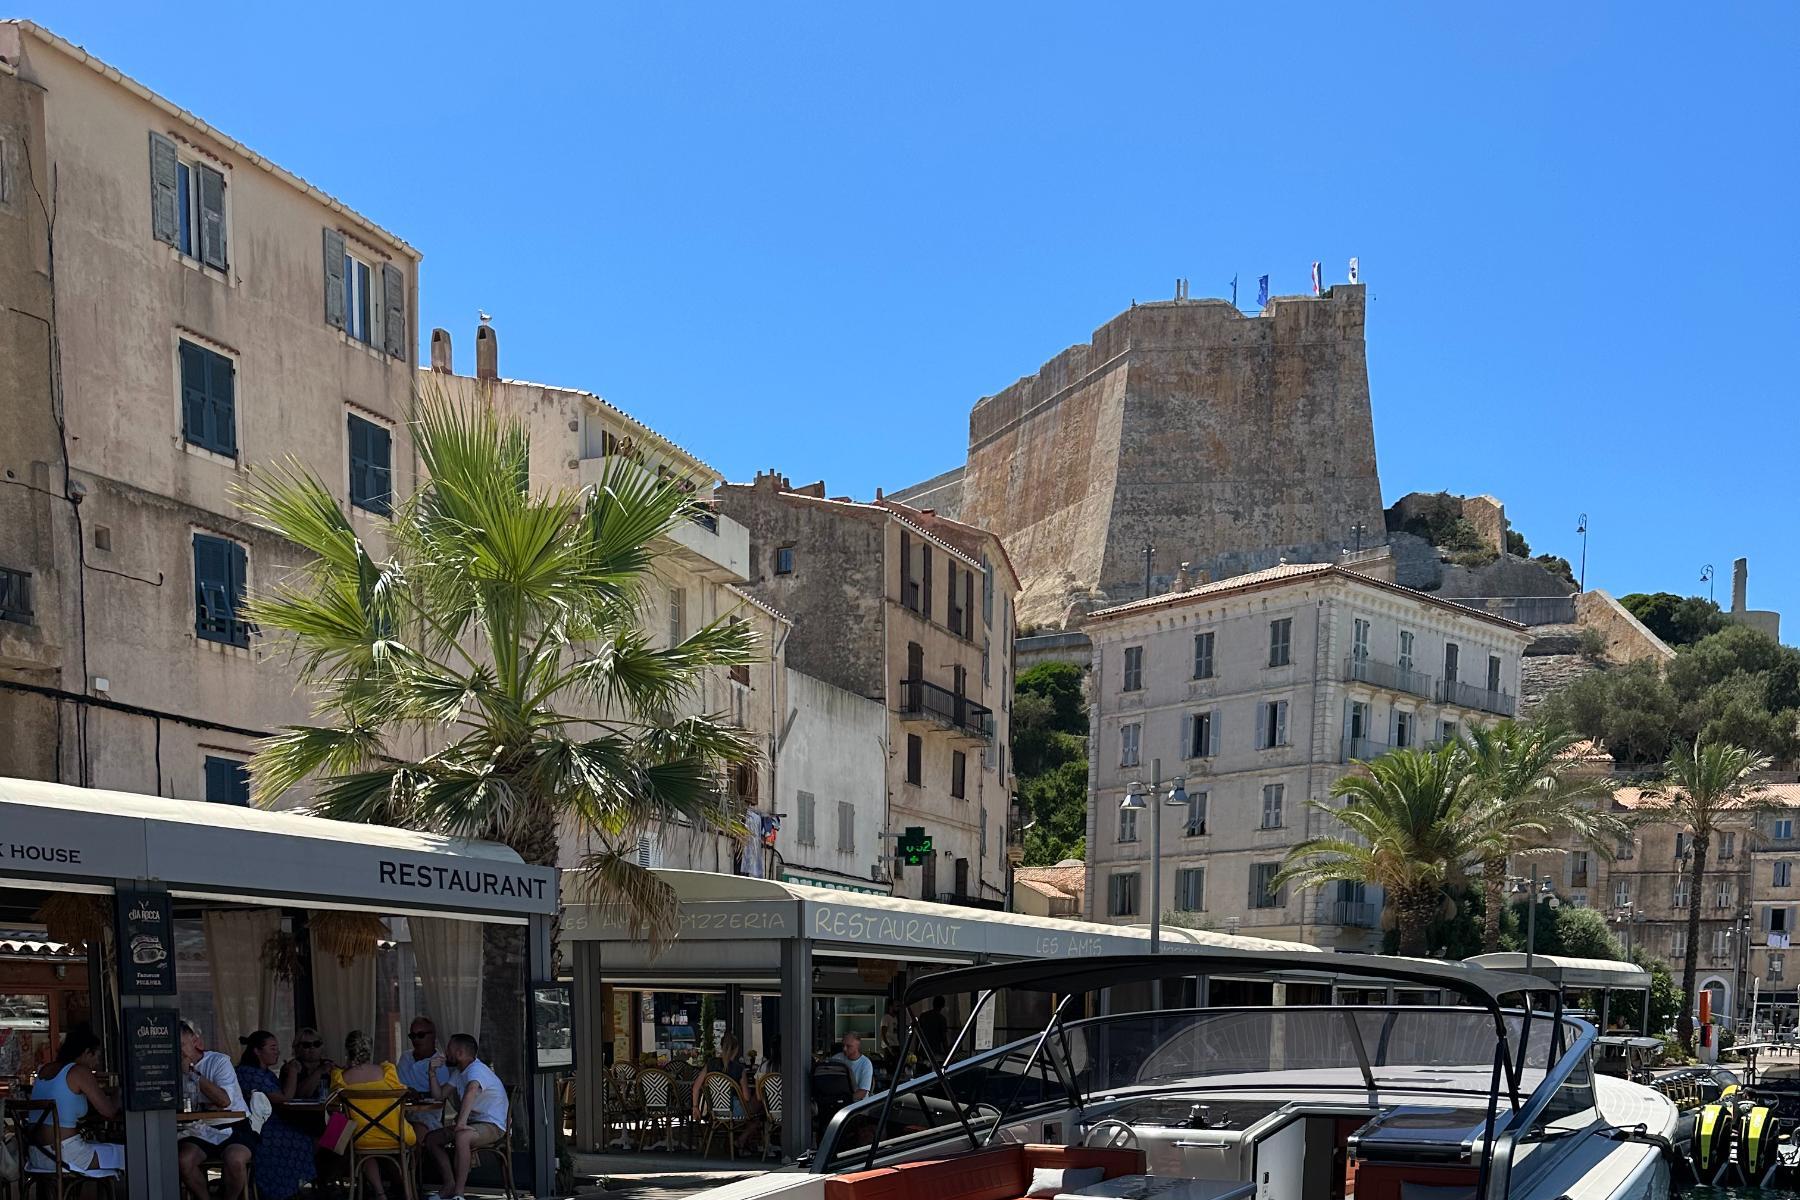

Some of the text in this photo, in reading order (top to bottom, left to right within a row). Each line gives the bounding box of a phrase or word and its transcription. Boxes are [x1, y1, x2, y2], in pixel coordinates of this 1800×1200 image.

[10, 843, 82, 865] HOUSE
[379, 860, 547, 900] RESTAURANT
[815, 907, 962, 946] RESTAURANT
[1036, 935, 1059, 954] LES
